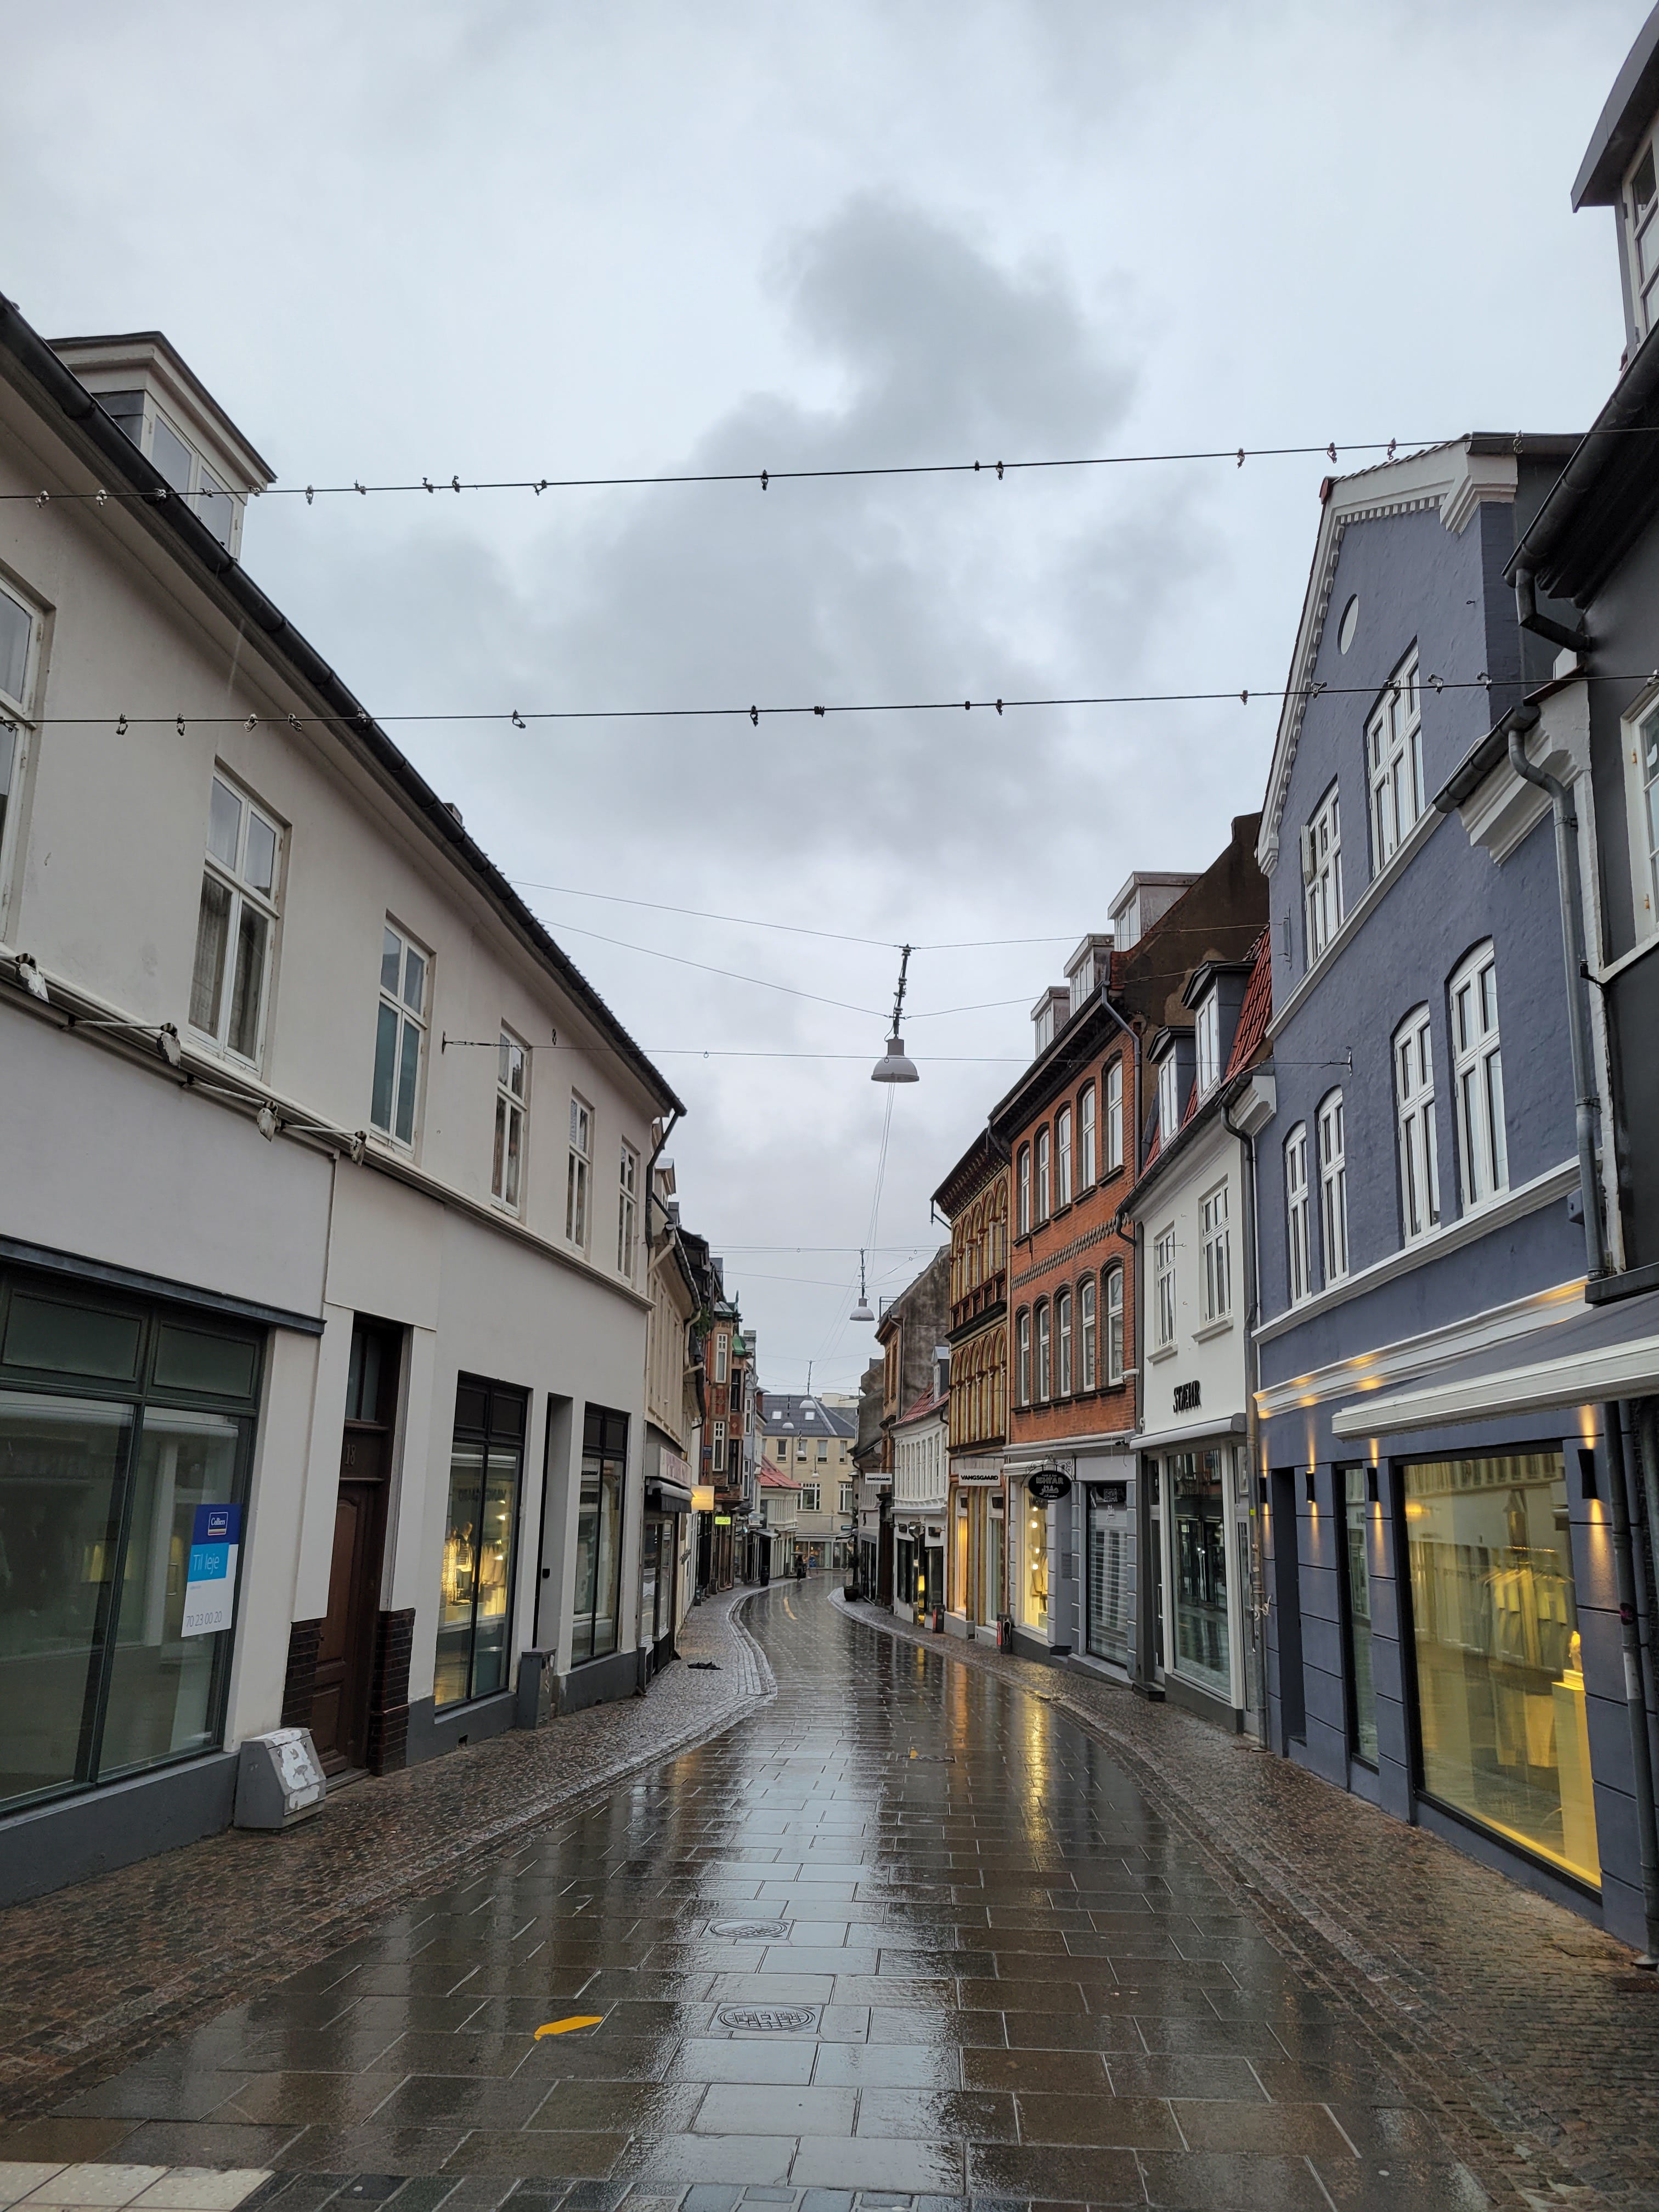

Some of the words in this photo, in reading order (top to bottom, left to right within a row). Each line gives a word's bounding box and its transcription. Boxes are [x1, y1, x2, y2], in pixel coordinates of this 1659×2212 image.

[345, 1444, 356, 1465] 18
[1036, 1476, 1064, 1485] ISHTAR
[193, 1553, 203, 1571] Til
[204, 1553, 220, 1575] leje
[186, 1615, 194, 1628] 70
[195, 1613, 204, 1627] 23
[205, 1612, 213, 1624] 00
[214, 1611, 222, 1623] 20
